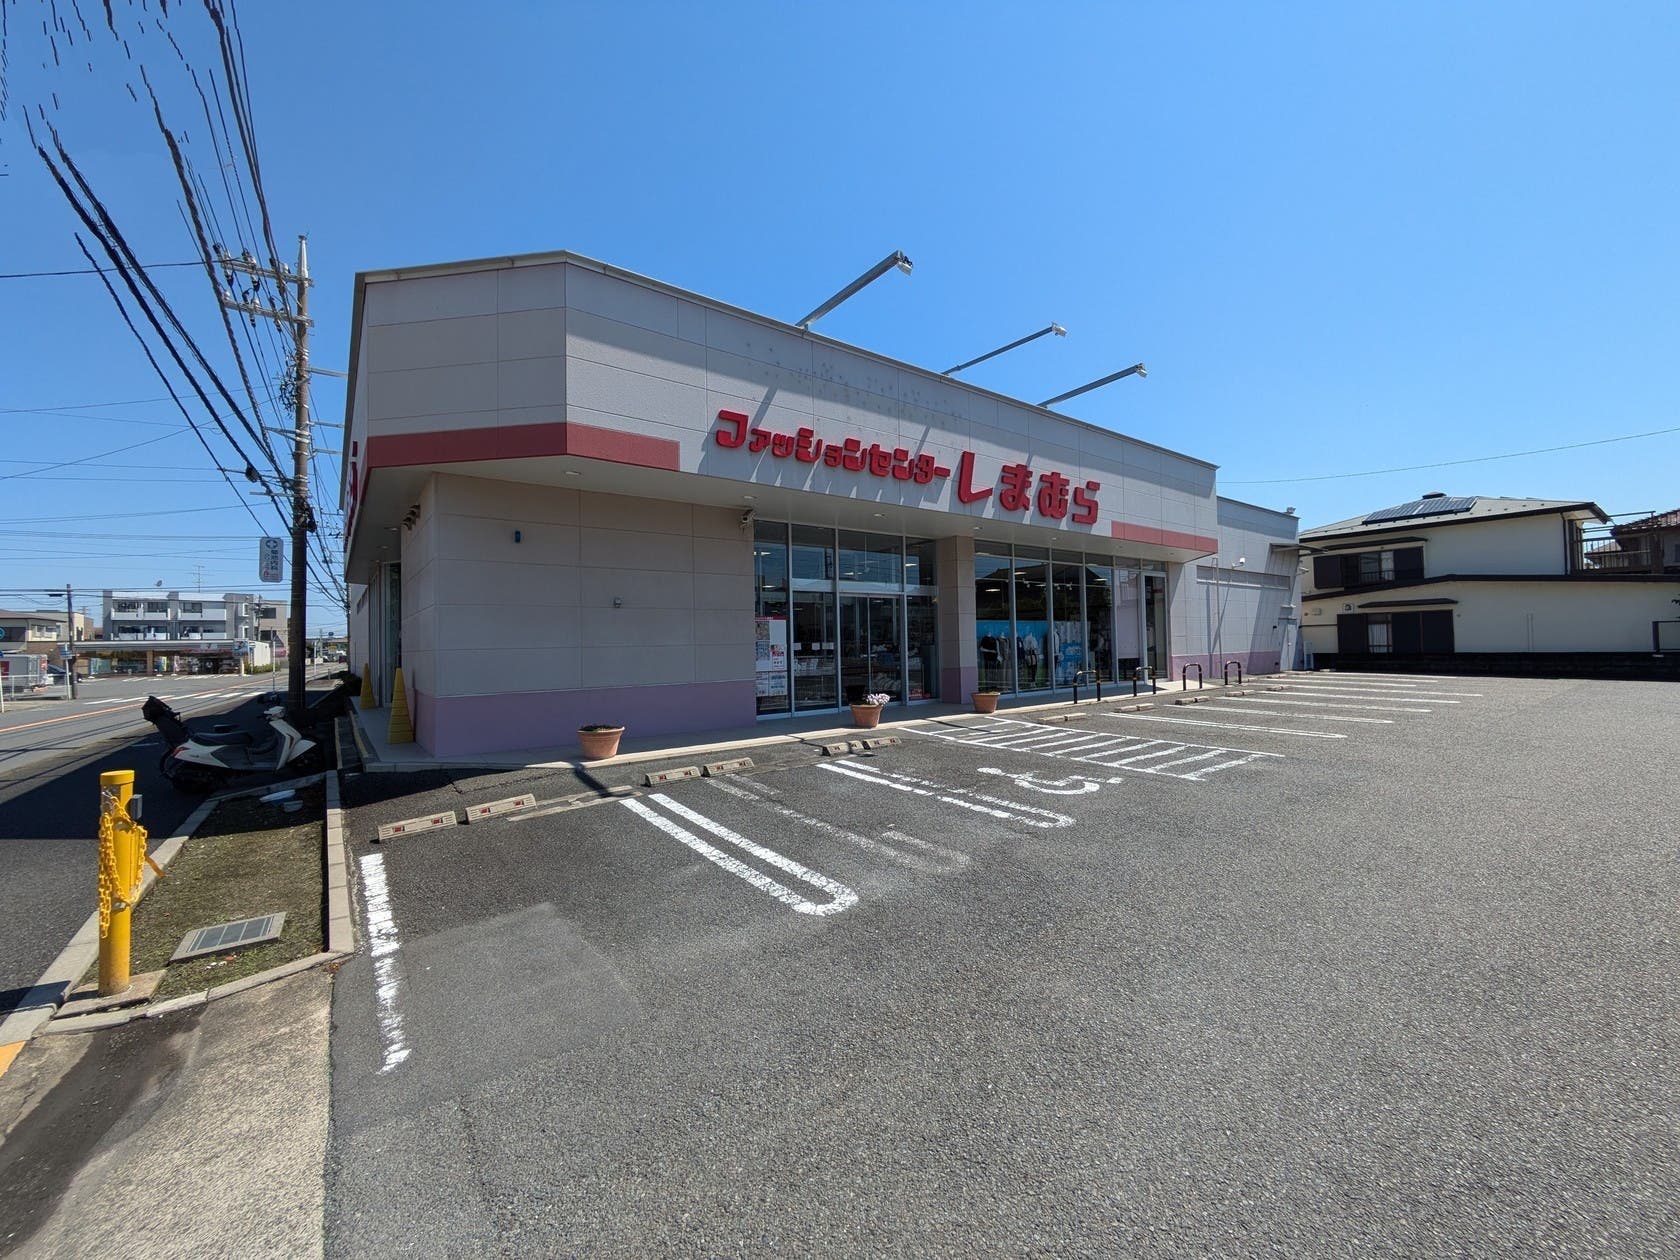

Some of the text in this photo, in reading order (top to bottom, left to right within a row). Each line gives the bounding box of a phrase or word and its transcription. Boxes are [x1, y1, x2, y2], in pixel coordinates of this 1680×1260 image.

[716, 410, 1100, 525] ファッションセンター しまむら
